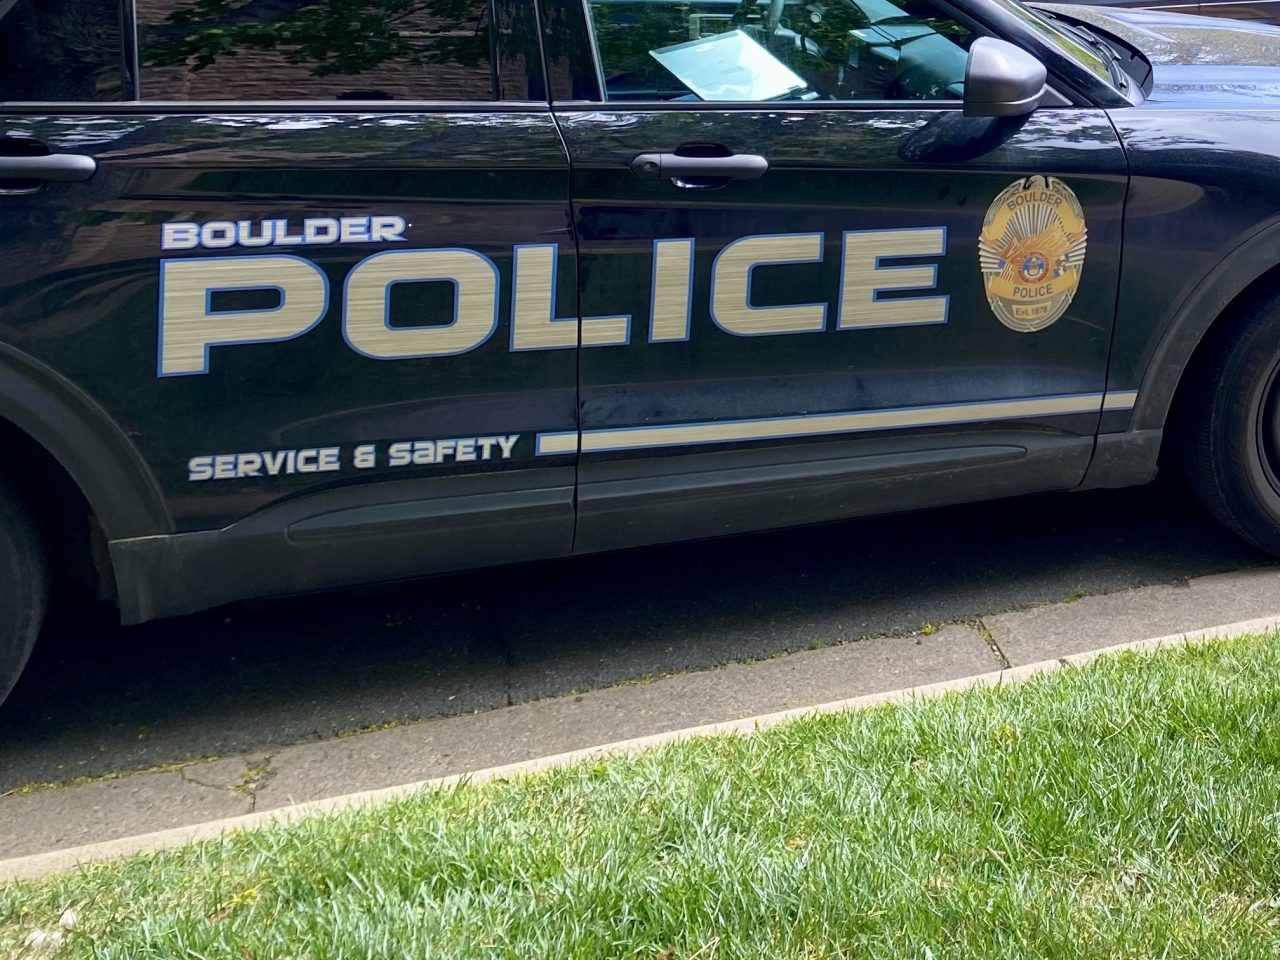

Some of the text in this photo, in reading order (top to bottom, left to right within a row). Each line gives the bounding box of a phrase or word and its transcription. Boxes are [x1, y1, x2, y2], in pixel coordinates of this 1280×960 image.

[1007, 192, 1063, 211] BOULDER
[161, 216, 408, 250] BOULDER
[157, 226, 951, 378] POLICE
[1013, 284, 1053, 298] POLICE
[188, 447, 341, 481] SERVICE
[353, 444, 376, 469] &
